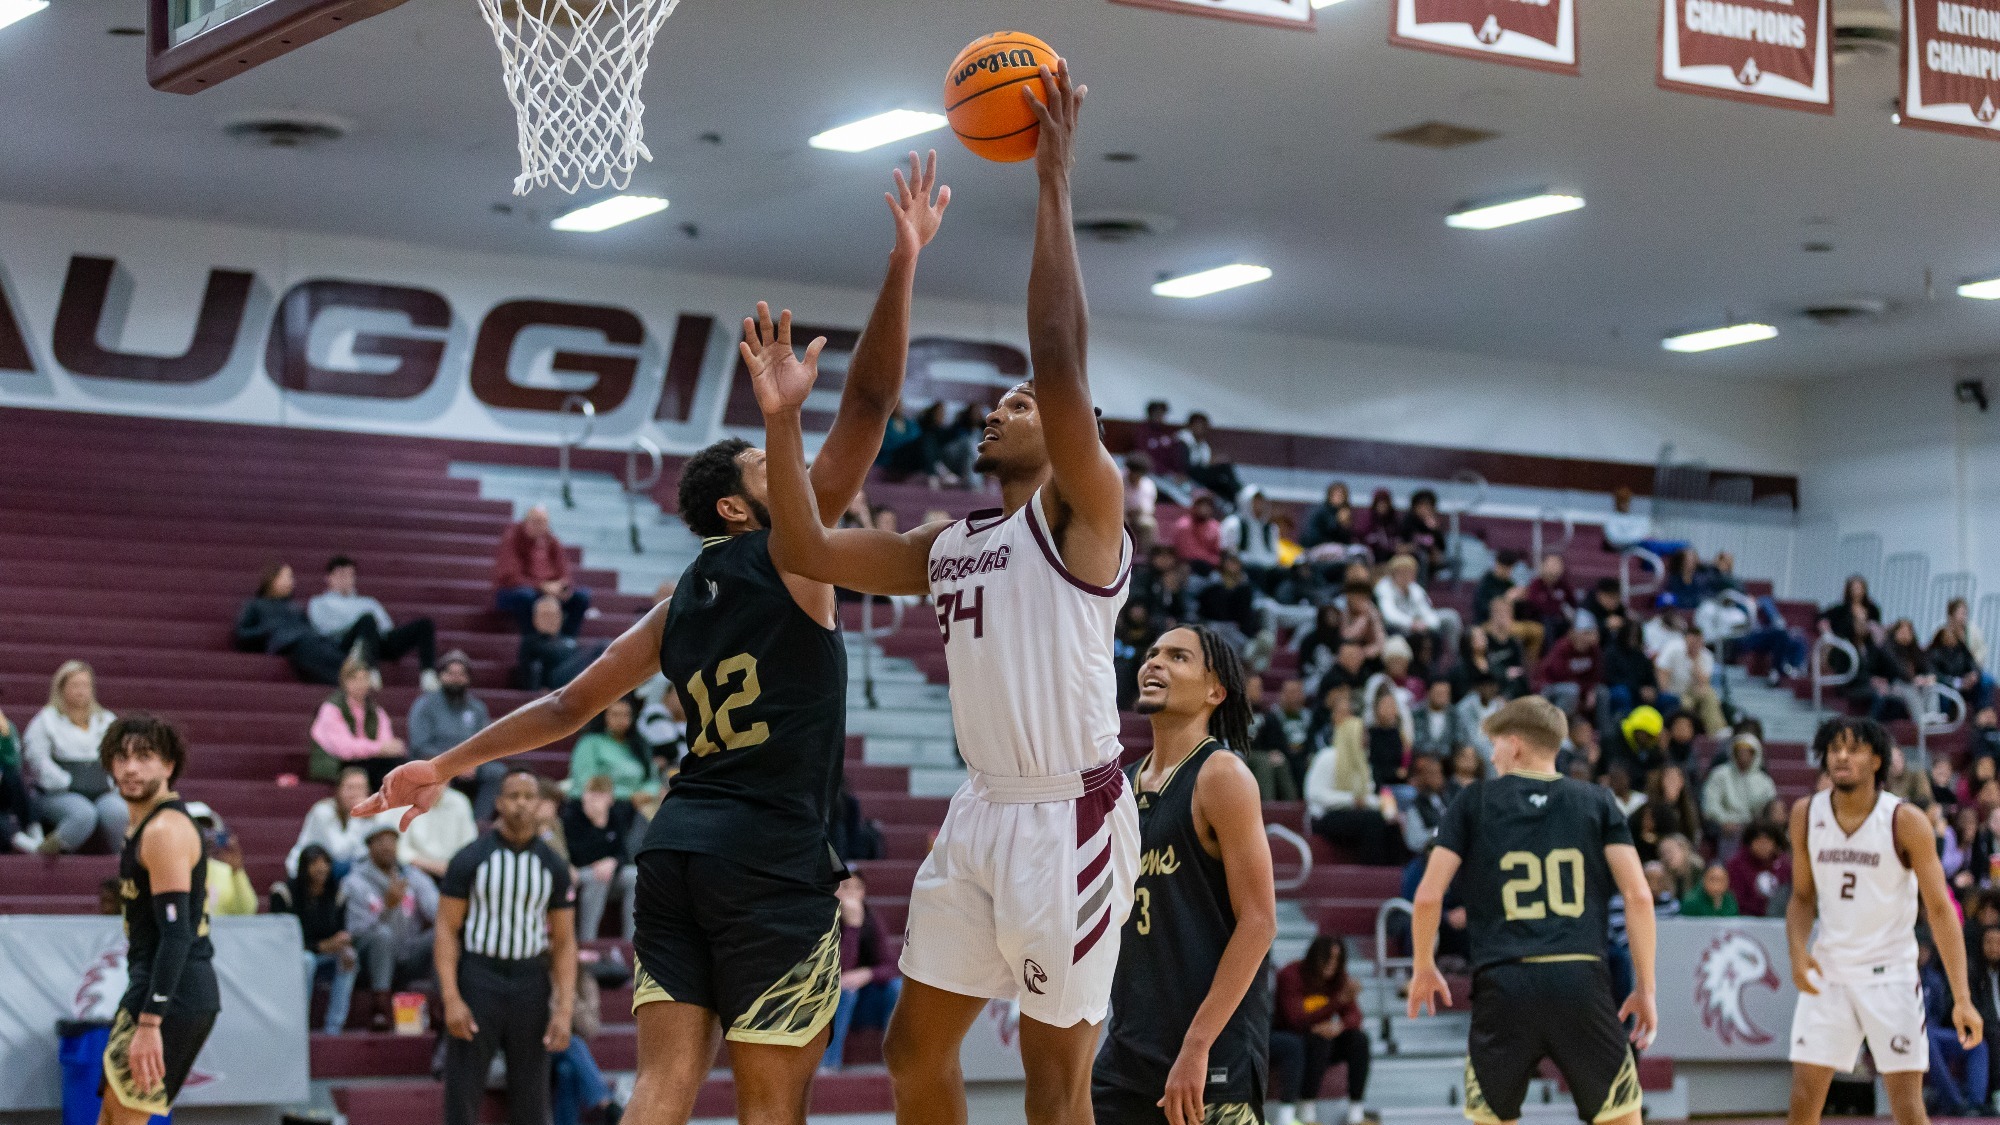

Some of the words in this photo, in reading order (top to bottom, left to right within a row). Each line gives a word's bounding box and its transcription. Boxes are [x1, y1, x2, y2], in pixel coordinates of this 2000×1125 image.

[1685, 0, 1807, 49] CHAMPIONS
[954, 48, 1038, 87] Wilson
[1926, 39, 2000, 81] CHAMPI
[936, 585, 985, 646] 34
[686, 652, 770, 758] 12
[1499, 847, 1585, 921] 20
[1841, 871, 1857, 900] 2
[1135, 886, 1151, 936] 3
